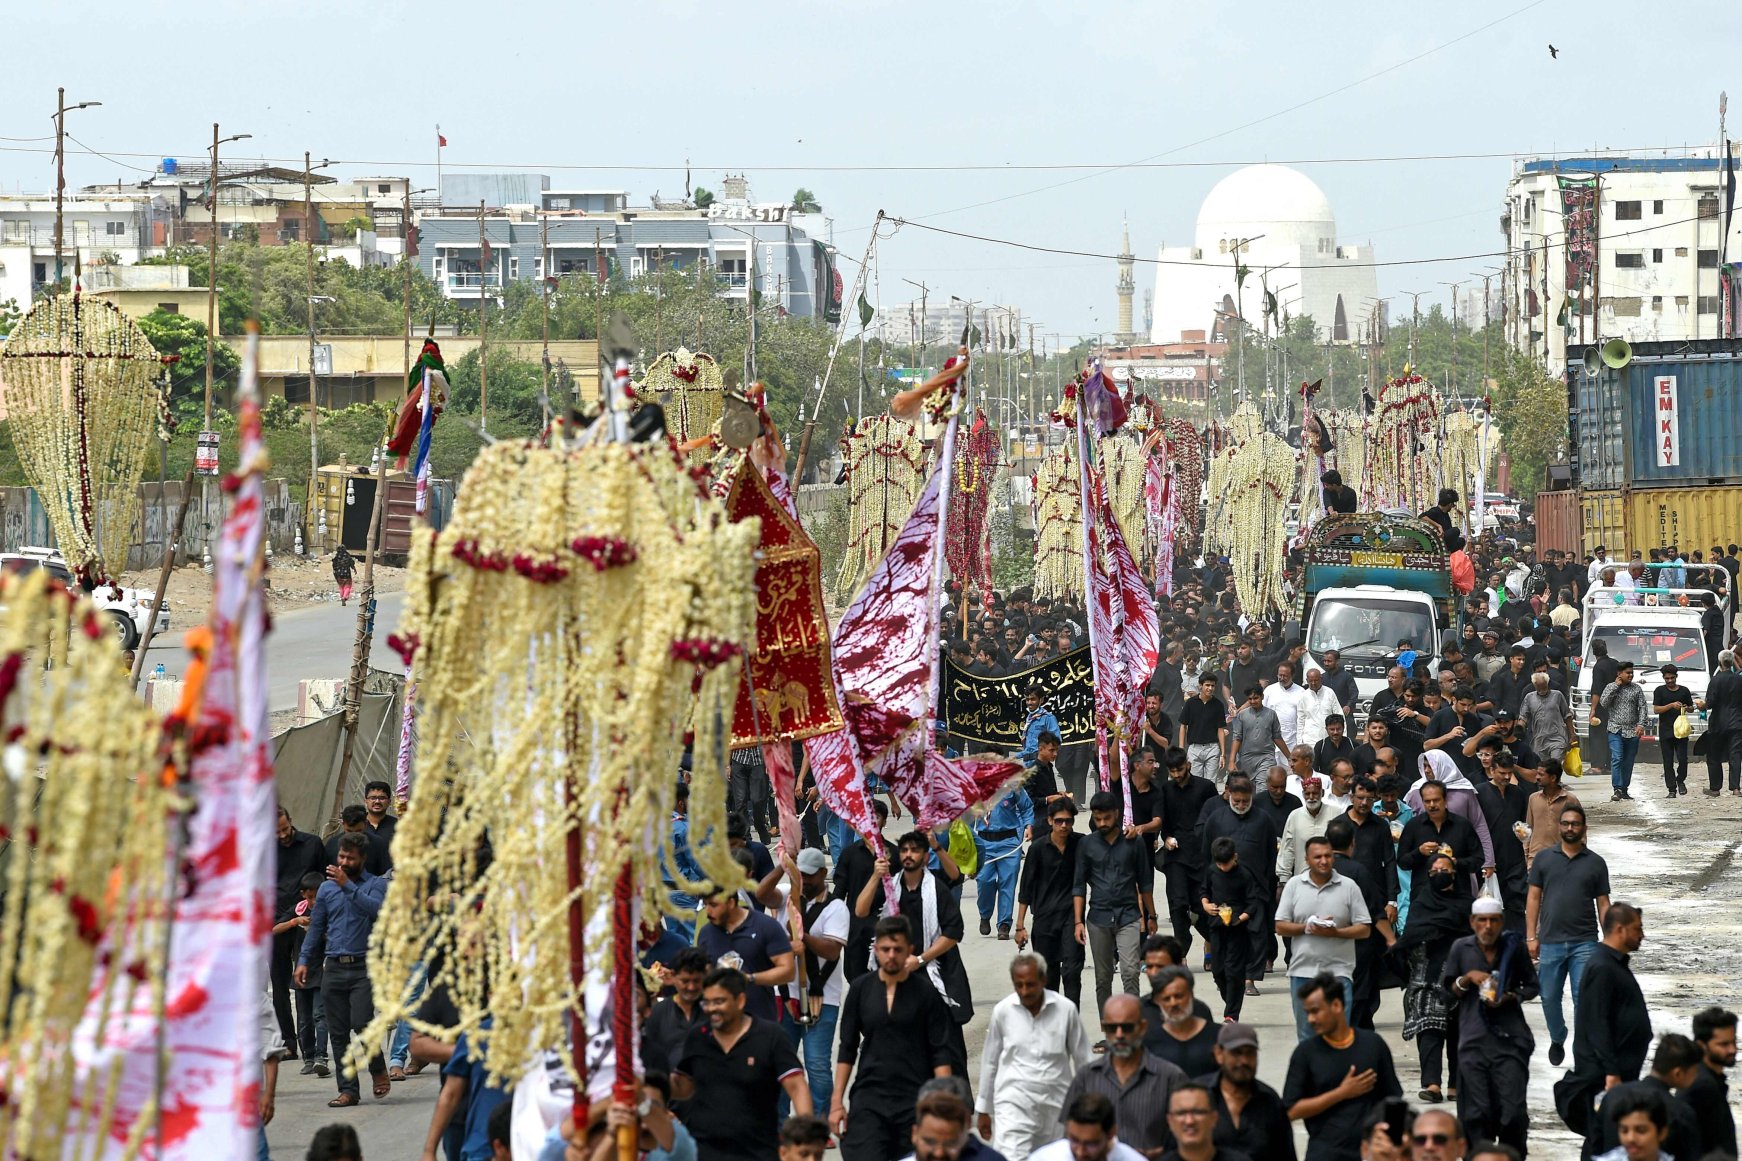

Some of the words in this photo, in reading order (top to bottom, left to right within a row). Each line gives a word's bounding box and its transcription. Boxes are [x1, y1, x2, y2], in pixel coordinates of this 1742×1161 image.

[1661, 420, 1672, 464] KAY
[1659, 505, 1667, 549] MEDITE
[1344, 664, 1389, 674] FOTO
